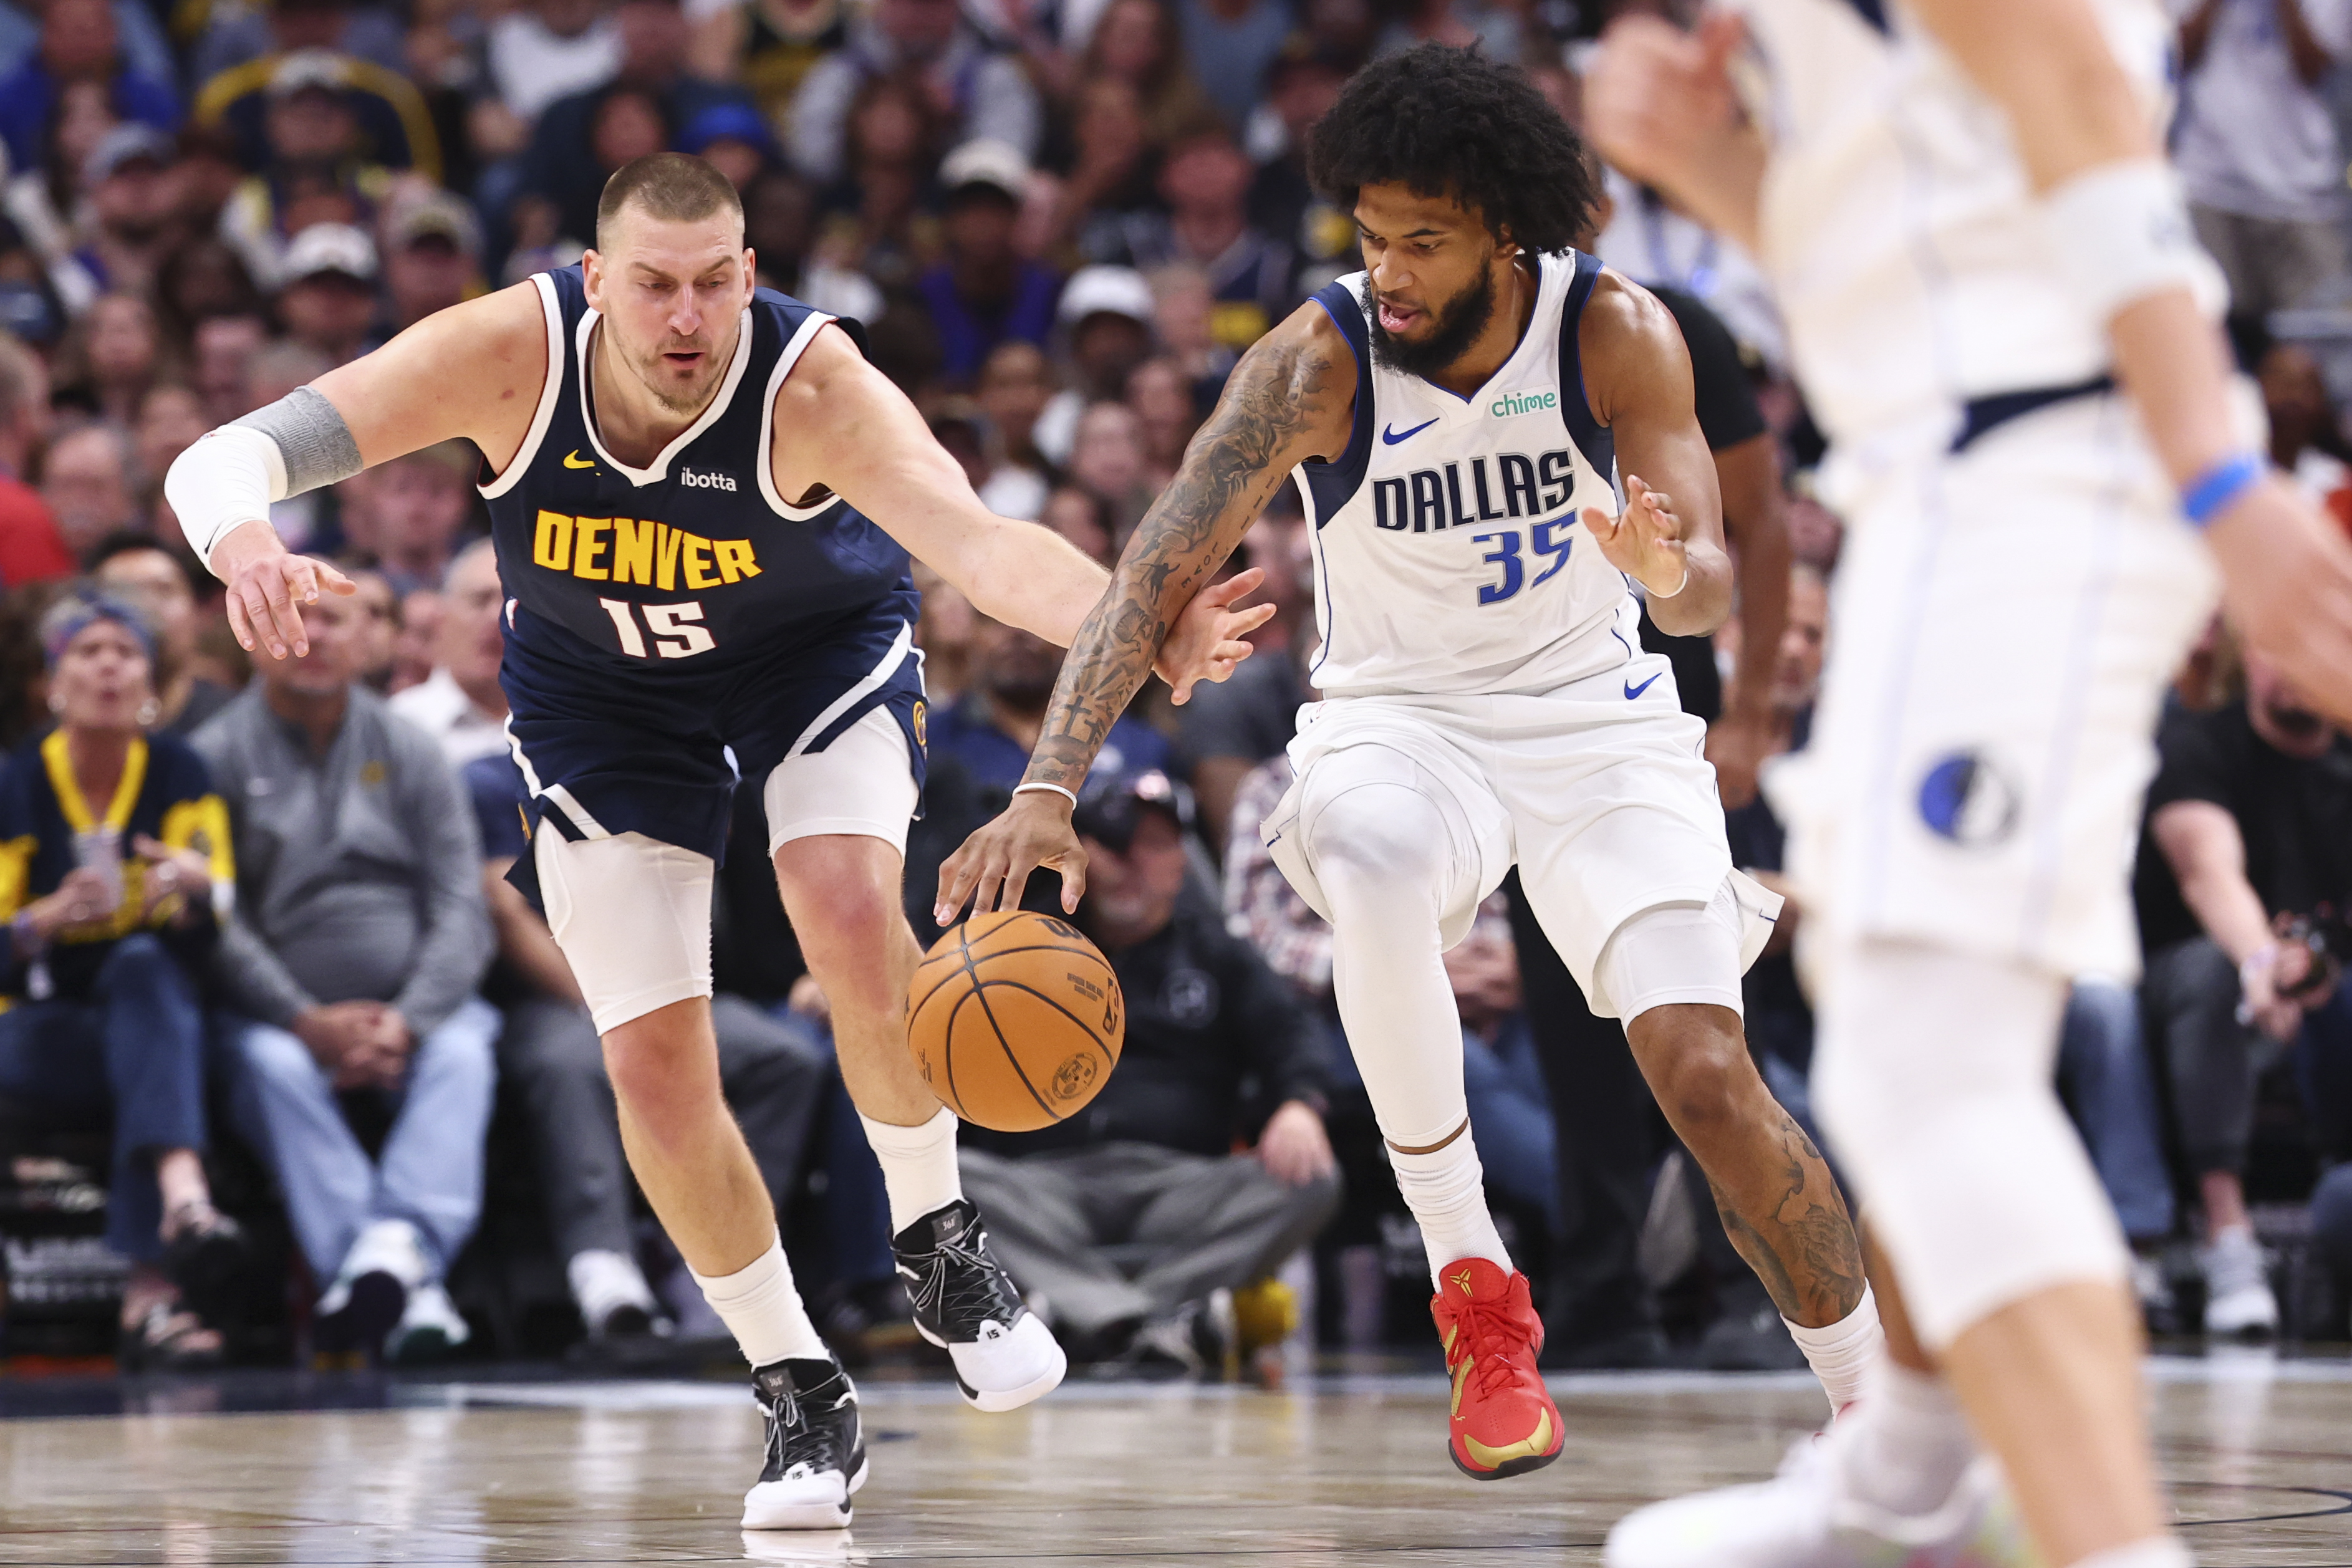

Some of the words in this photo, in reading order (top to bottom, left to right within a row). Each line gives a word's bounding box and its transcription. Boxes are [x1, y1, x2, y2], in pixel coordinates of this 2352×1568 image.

[1492, 392, 1556, 417] chime
[681, 466, 737, 492] ibotta
[1371, 447, 1576, 534] DALLAS
[533, 509, 764, 591] DENVER
[1470, 507, 1578, 607] 35
[599, 596, 718, 659] 15
[986, 1328, 1000, 1340] 15
